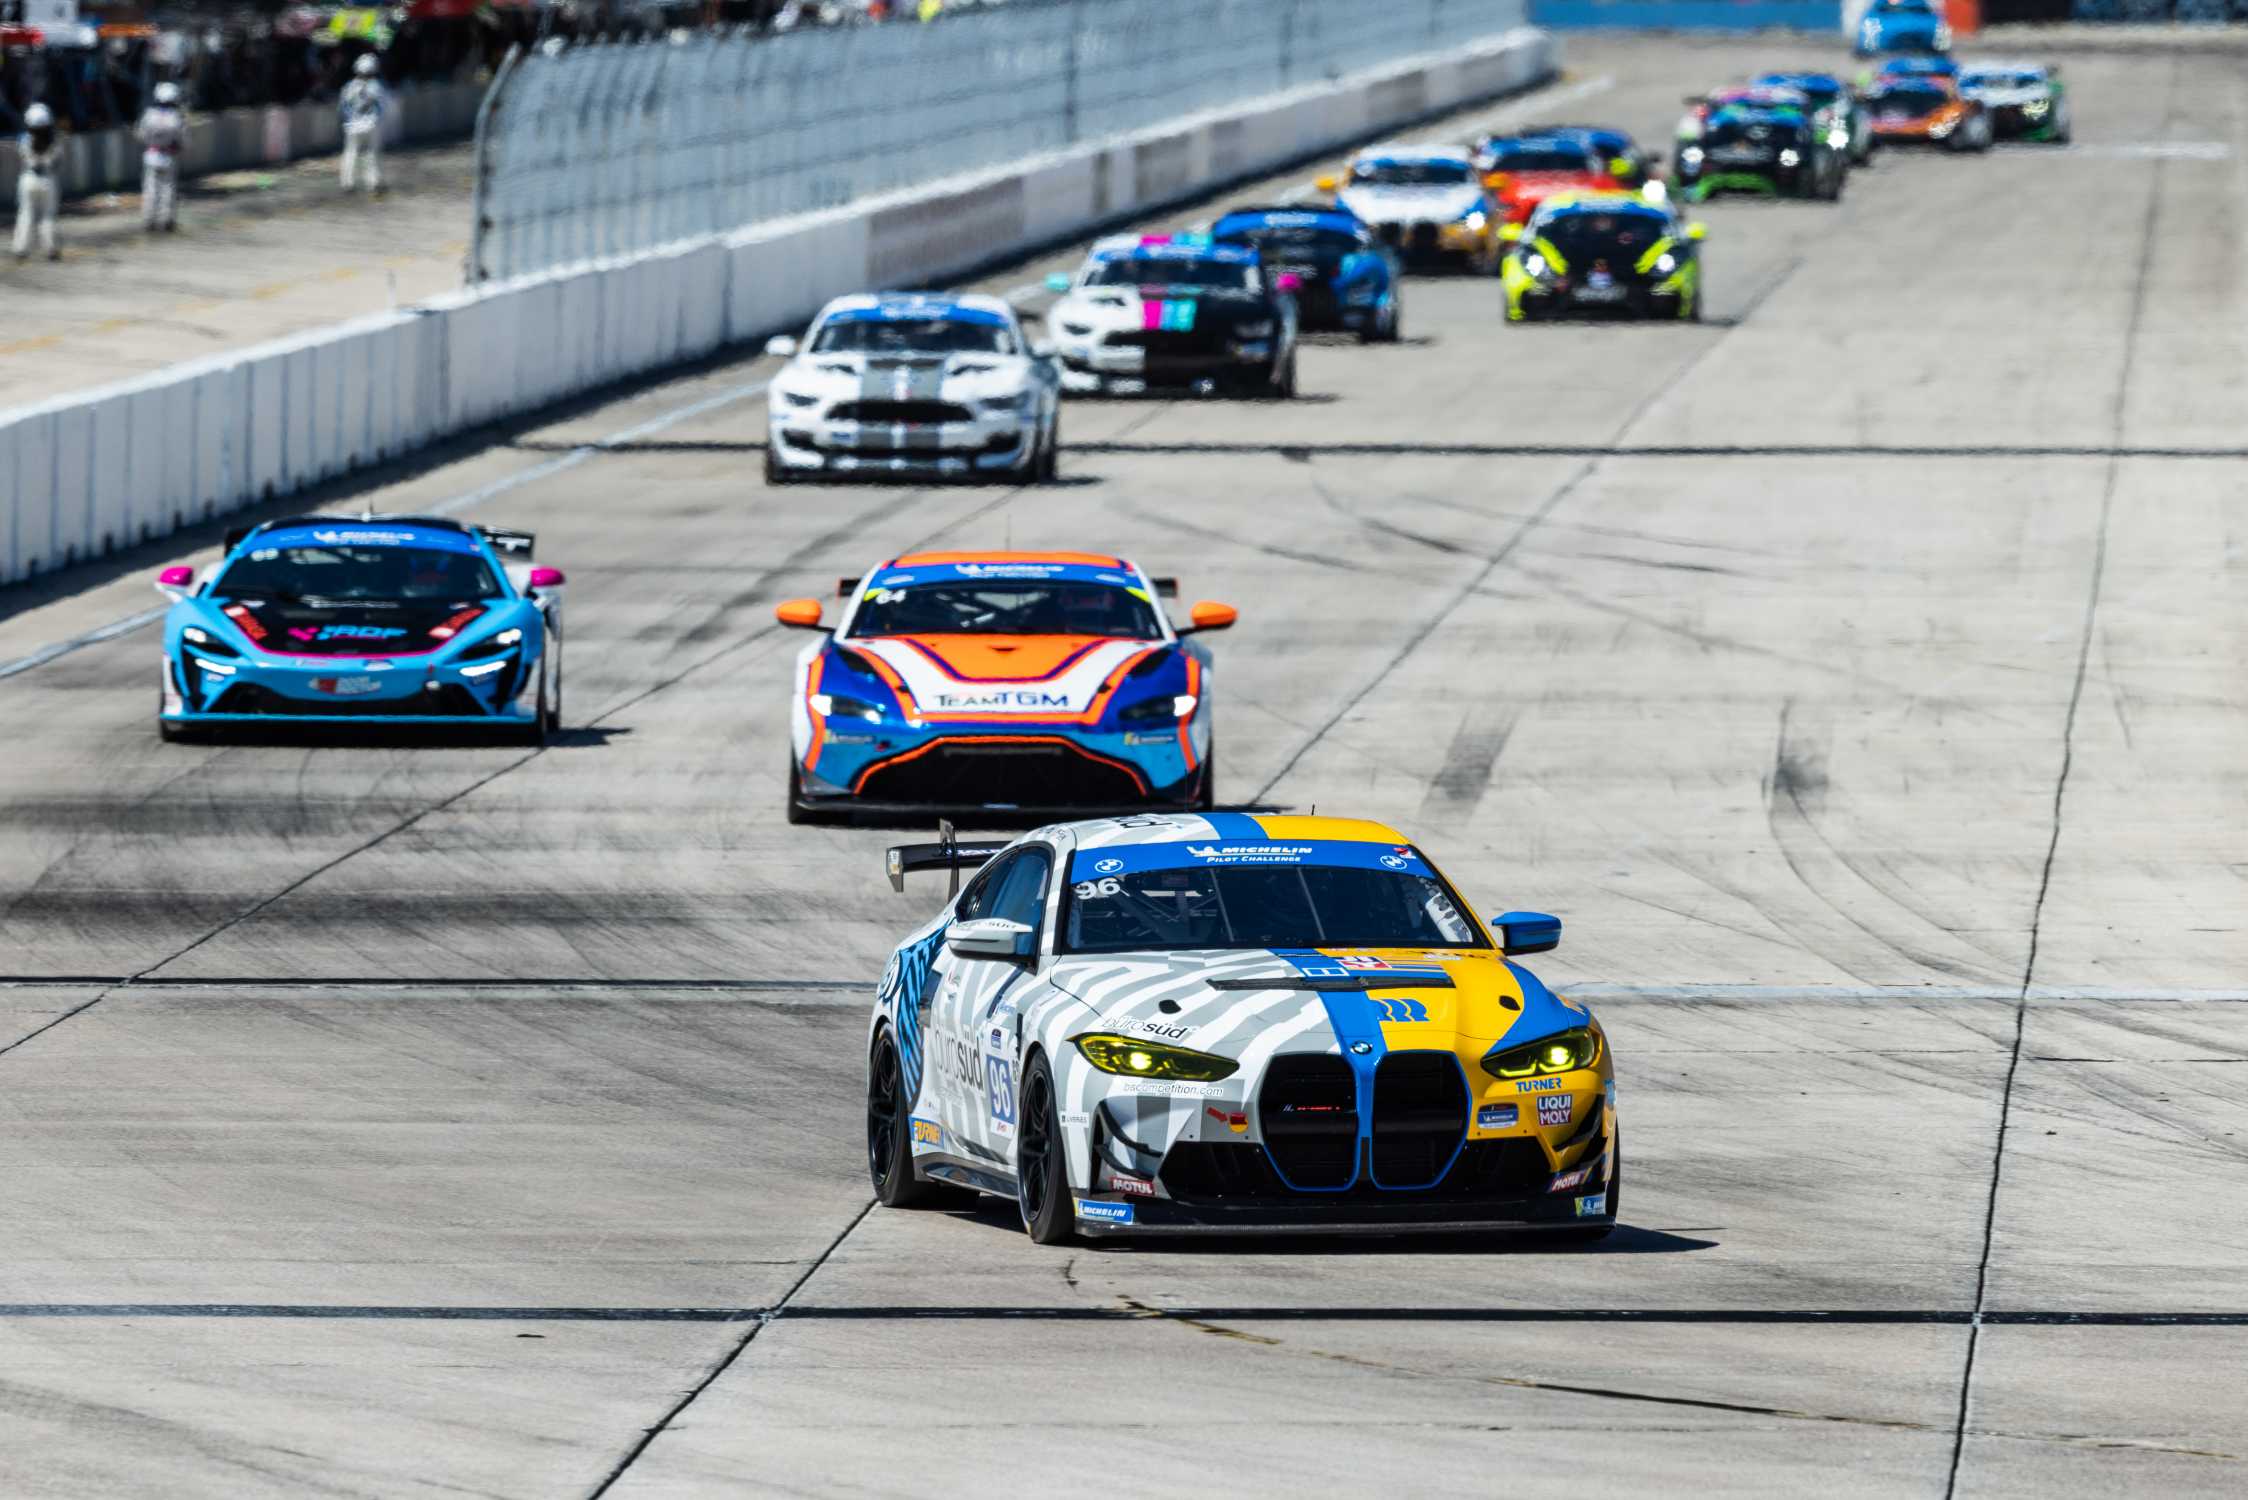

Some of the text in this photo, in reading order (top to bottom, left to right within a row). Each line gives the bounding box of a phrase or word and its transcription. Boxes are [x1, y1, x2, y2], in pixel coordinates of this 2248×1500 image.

[1241, 855, 1301, 863] CHALLENGE
[1075, 877, 1121, 900] 96
[989, 1059, 1011, 1119] 96
[1516, 1077, 1562, 1092] TURNER
[1539, 1095, 1571, 1110] LIQUI
[1540, 1109, 1571, 1125] MOLY
[1112, 1179, 1153, 1194] MOTUL
[1083, 1205, 1127, 1217] MICHELIN
